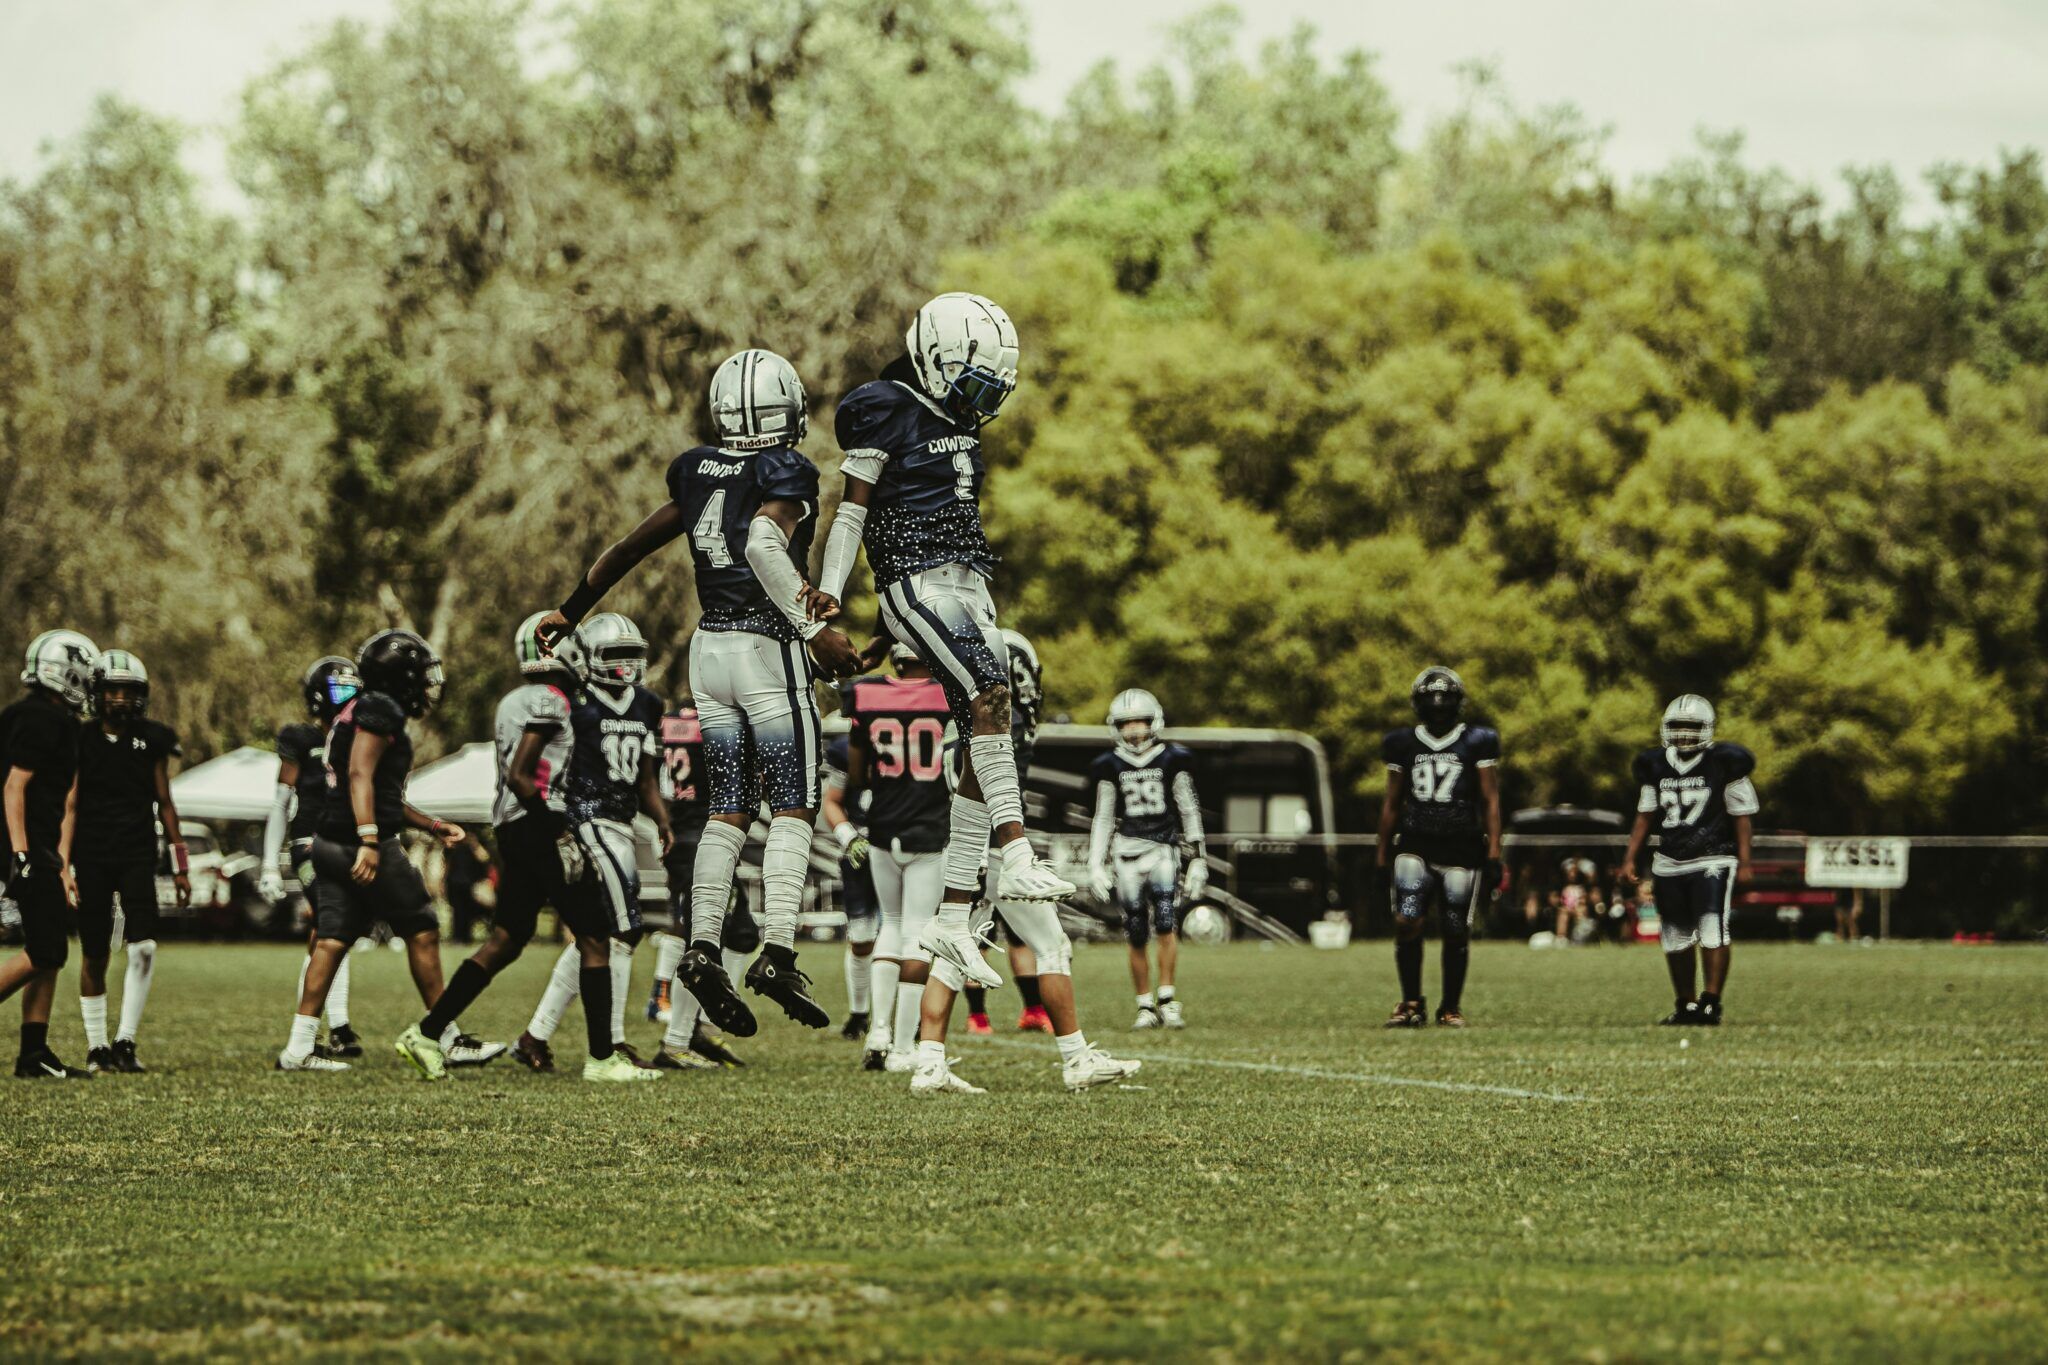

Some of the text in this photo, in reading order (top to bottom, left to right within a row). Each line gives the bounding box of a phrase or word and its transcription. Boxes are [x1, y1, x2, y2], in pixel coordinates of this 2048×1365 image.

[735, 437, 776, 449] Riddell
[928, 435, 979, 454] COWBO
[697, 459, 745, 478] COWS
[952, 451, 974, 500] 1
[694, 489, 733, 568] 4
[601, 733, 641, 785] 10
[869, 717, 944, 782] 90
[1120, 780, 1167, 817] 29
[1411, 762, 1463, 803] 97
